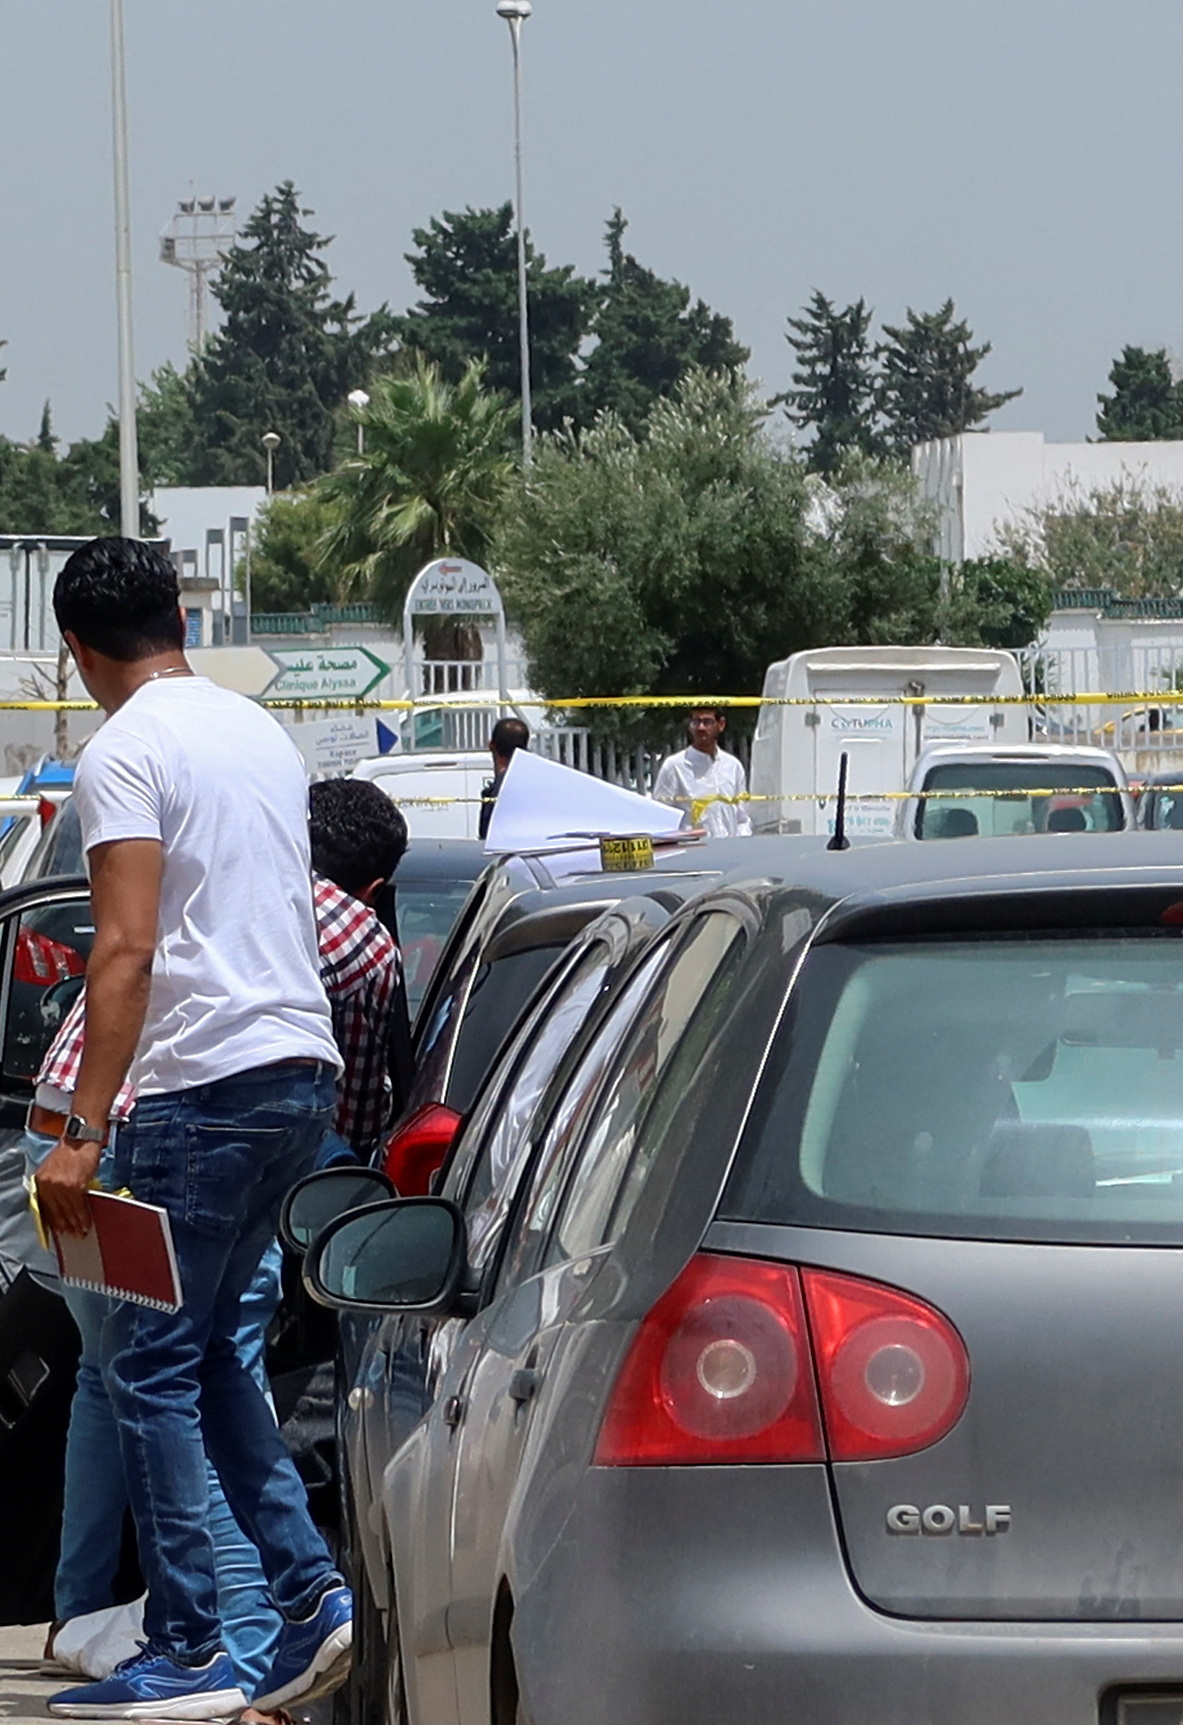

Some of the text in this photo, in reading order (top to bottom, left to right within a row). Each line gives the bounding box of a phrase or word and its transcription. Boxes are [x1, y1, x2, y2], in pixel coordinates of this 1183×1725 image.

[274, 677, 356, 692] Clinique Alyssa
[886, 1504, 1012, 1534] GOLF
